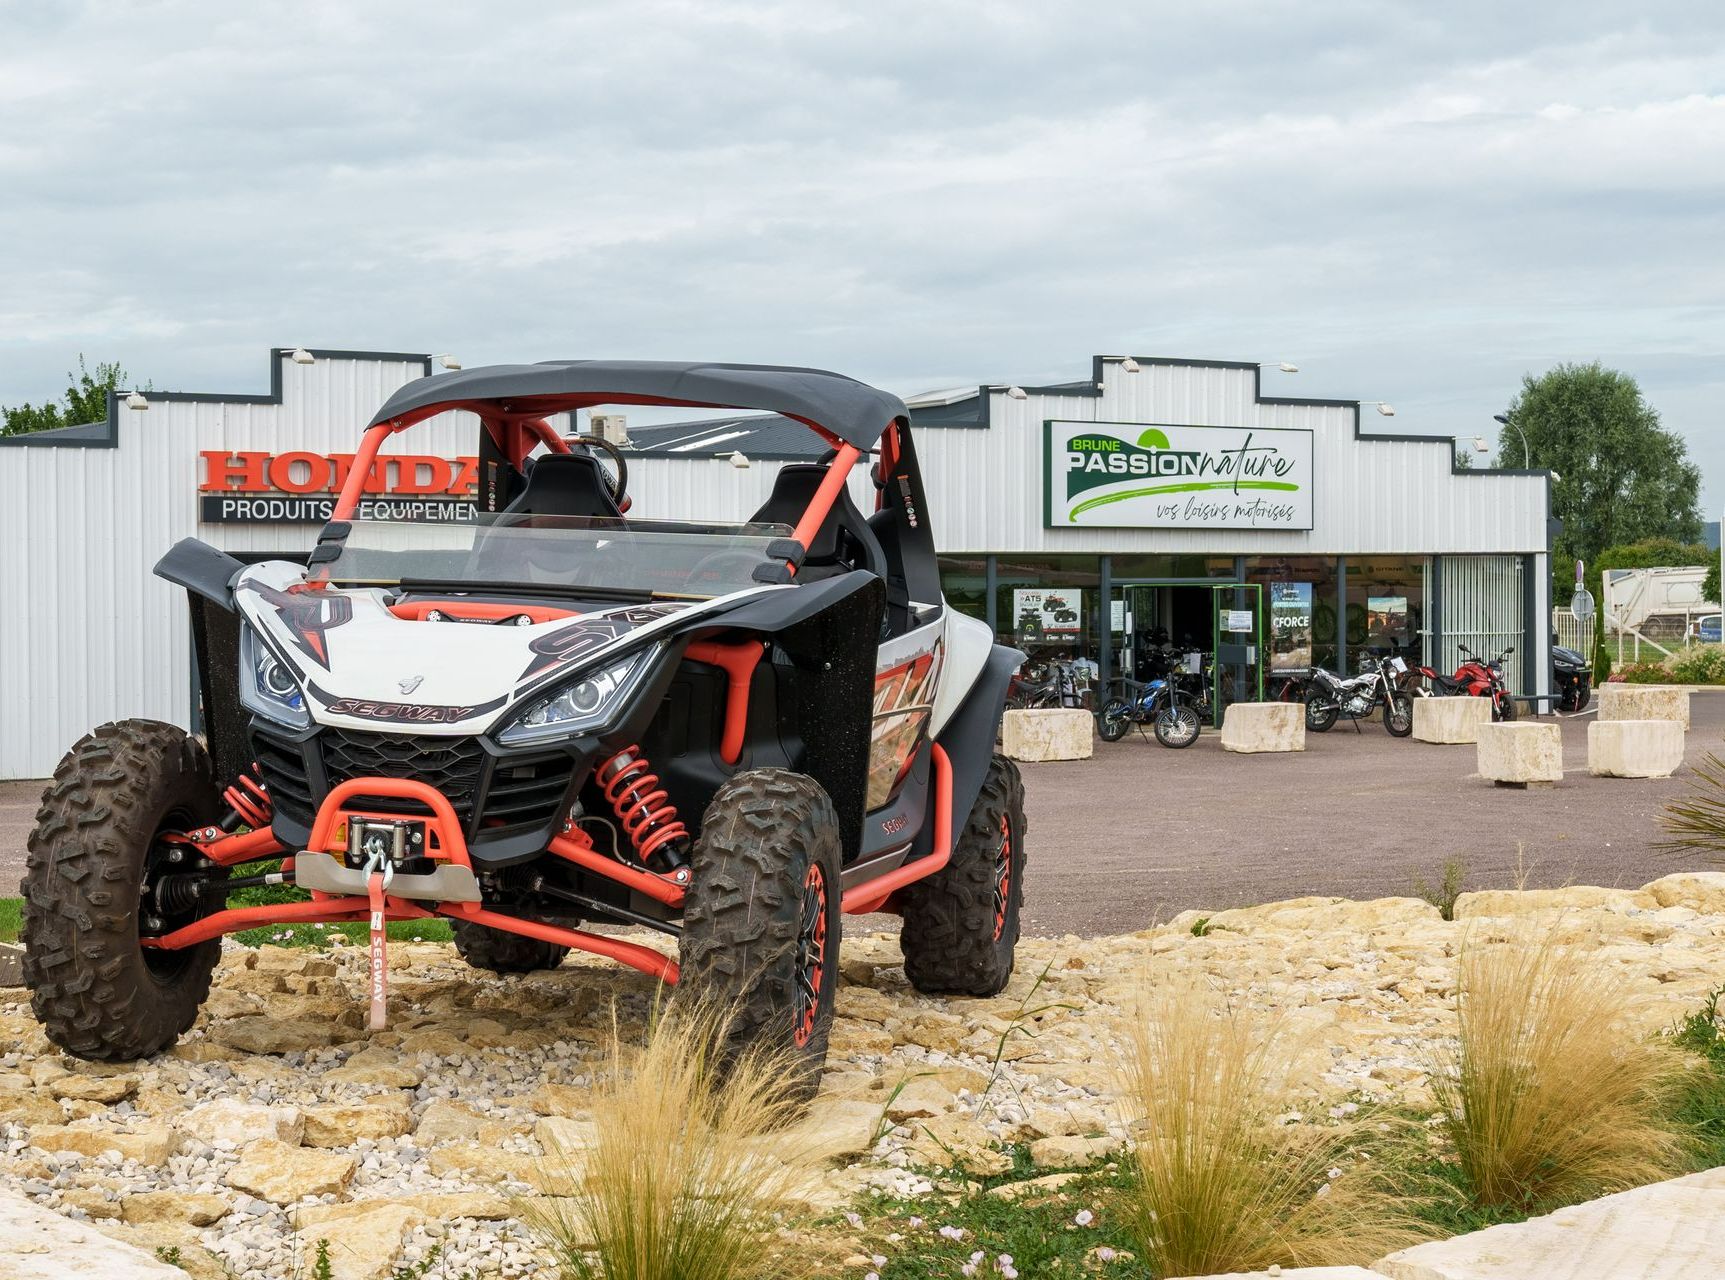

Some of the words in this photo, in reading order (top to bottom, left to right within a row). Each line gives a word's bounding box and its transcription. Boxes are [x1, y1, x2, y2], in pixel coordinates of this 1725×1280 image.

[1072, 439, 1120, 452] BRUNE
[1199, 432, 1296, 496] nature
[222, 500, 333, 520] PRODUITS
[1156, 503, 1180, 519] vos
[1184, 496, 1230, 521] loisirs
[1272, 615, 1310, 628] CFORCE
[329, 699, 475, 722] SEGWAY
[372, 936, 383, 1003] SEGWAY
